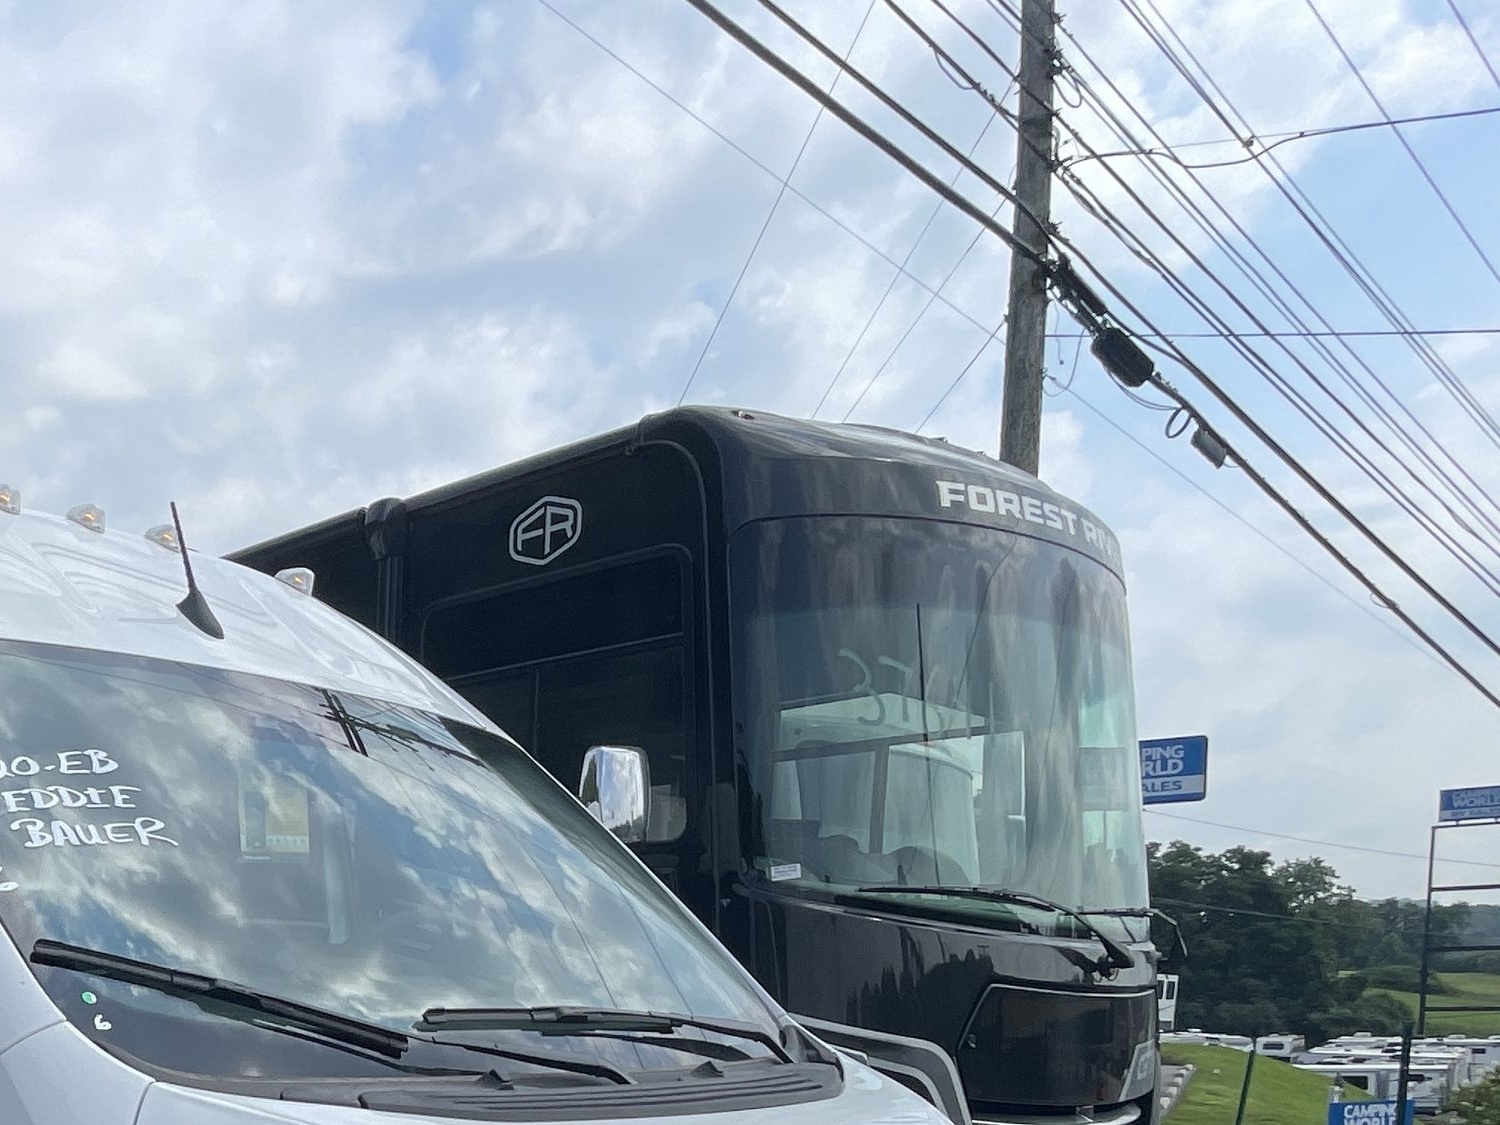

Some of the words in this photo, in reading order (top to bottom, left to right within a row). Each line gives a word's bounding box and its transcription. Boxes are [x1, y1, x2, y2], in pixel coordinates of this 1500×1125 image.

[935, 480, 1077, 536] FOREST
[516, 504, 576, 556] FR
[1142, 744, 1185, 761] PING
[1142, 758, 1185, 777] RLD
[1, 785, 142, 813] EDDIE
[1142, 780, 1183, 793] ALES
[10, 817, 179, 848] BAUER
